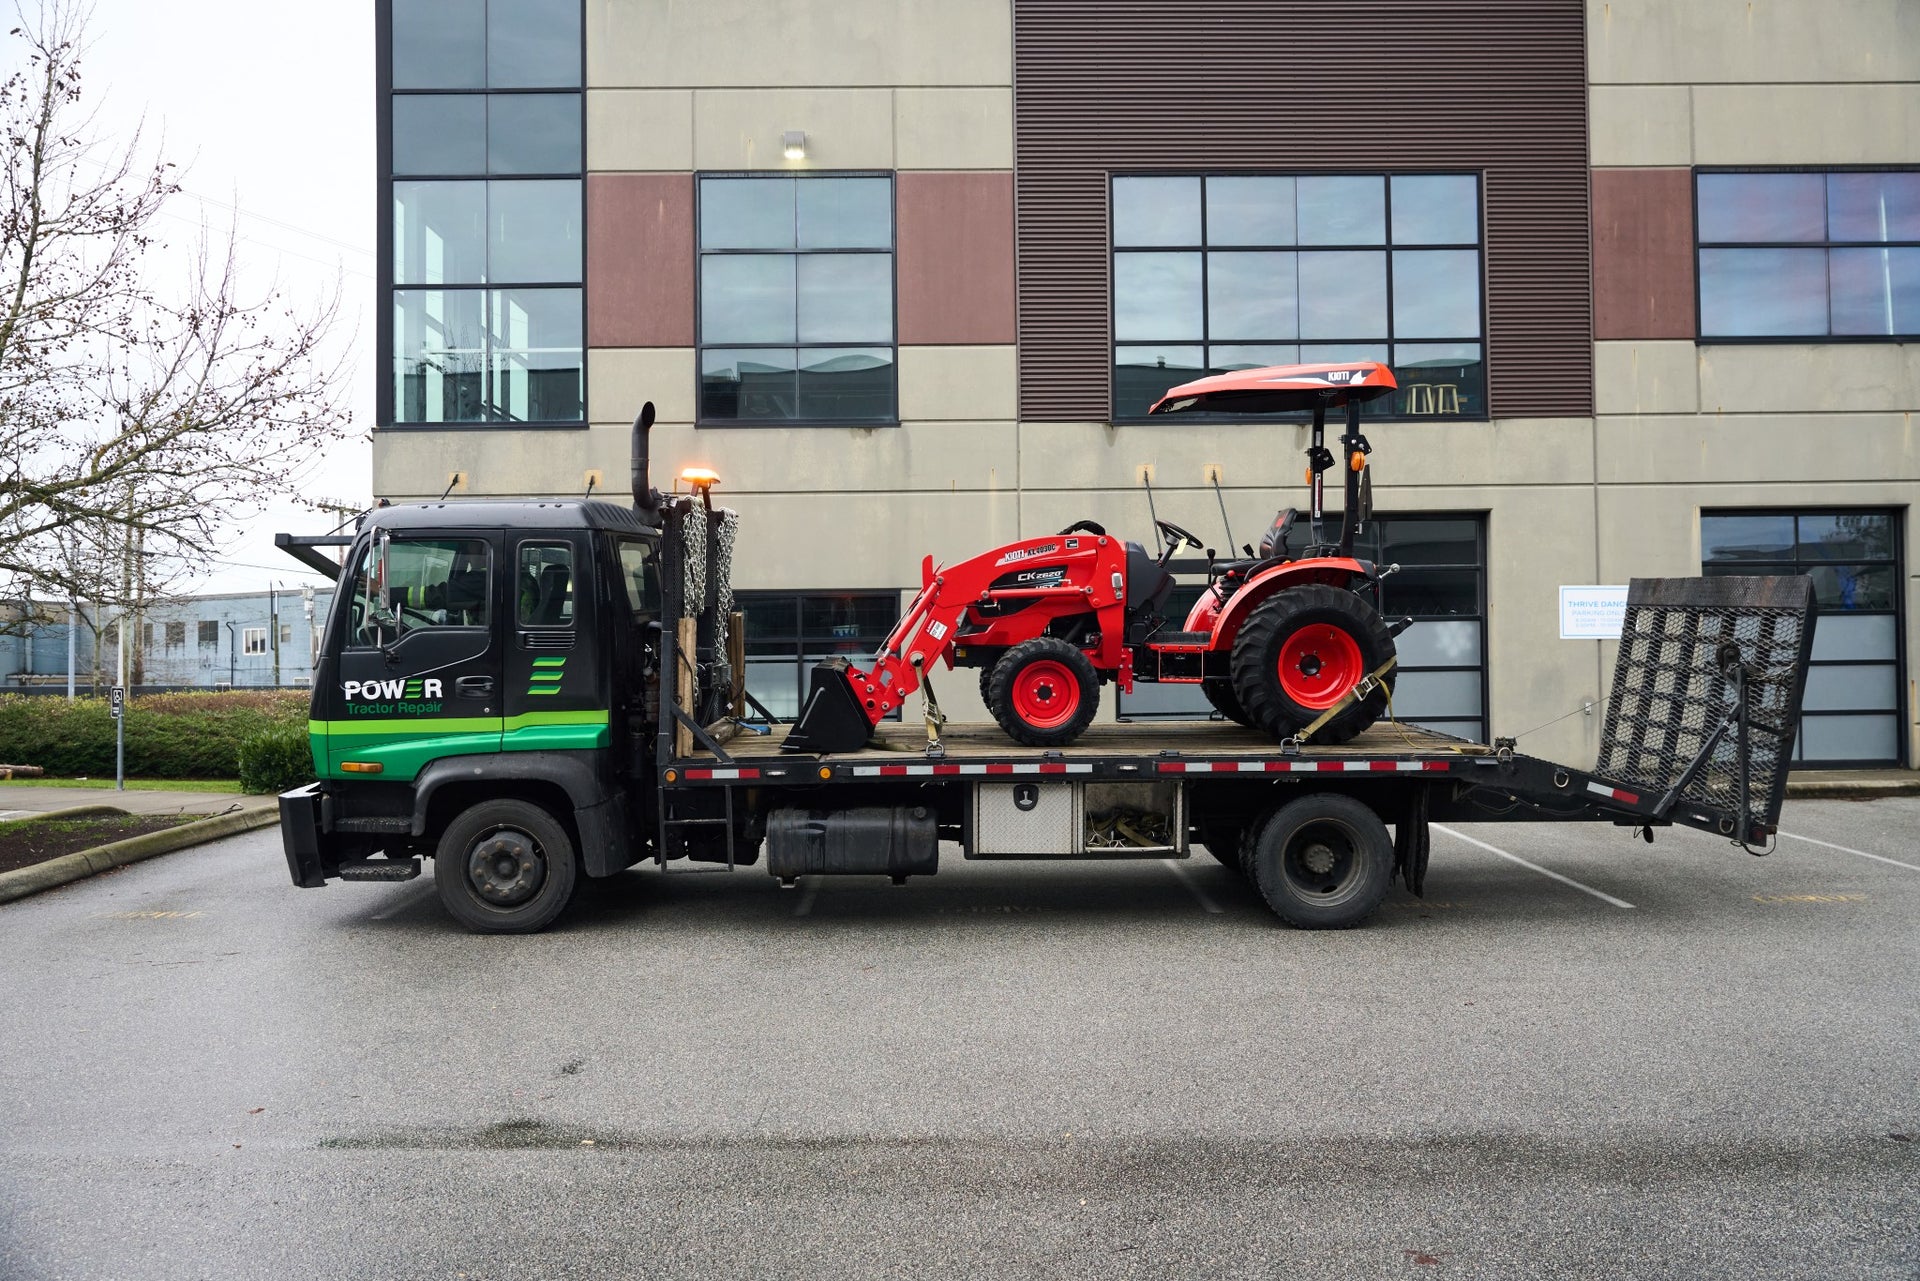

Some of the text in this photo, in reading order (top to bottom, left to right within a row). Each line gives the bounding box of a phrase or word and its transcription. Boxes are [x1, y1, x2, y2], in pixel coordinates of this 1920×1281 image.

[1328, 371, 1349, 381] KIOTI
[1004, 549, 1025, 562] KIOTI
[344, 679, 443, 700] POWER
[346, 701, 442, 715] Tractor Repair
